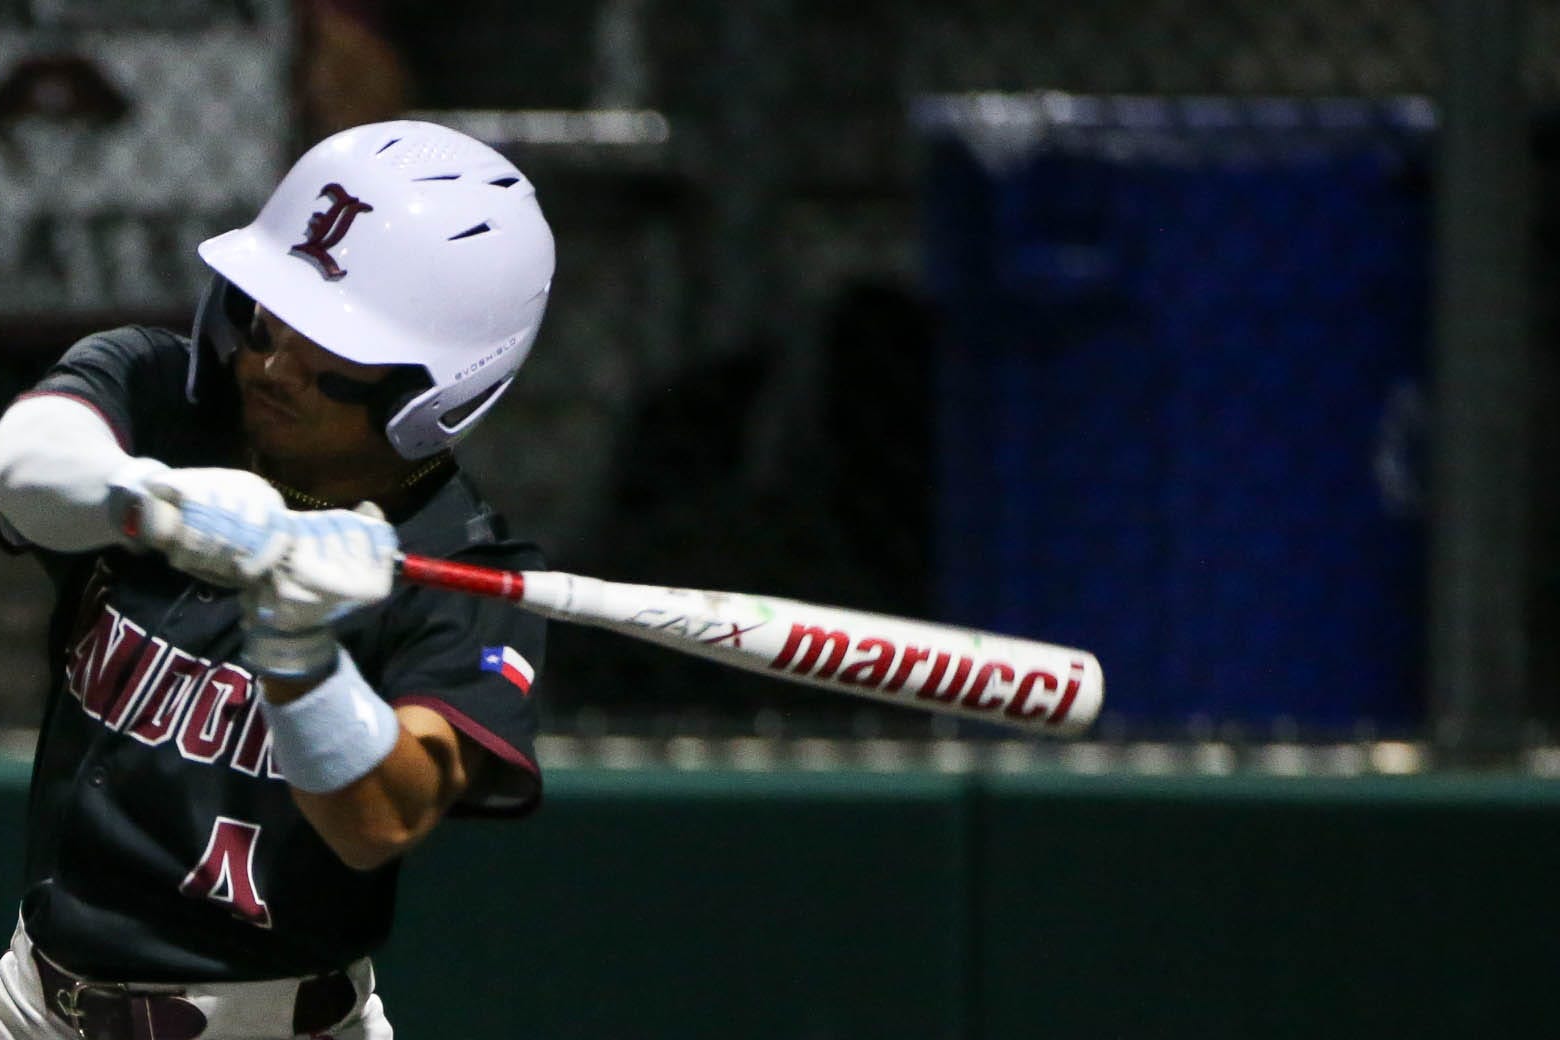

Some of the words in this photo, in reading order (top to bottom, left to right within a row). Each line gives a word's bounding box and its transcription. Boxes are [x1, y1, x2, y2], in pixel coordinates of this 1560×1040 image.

[288, 181, 374, 282] L
[771, 622, 1085, 725] marucci
[178, 815, 273, 931] 4
